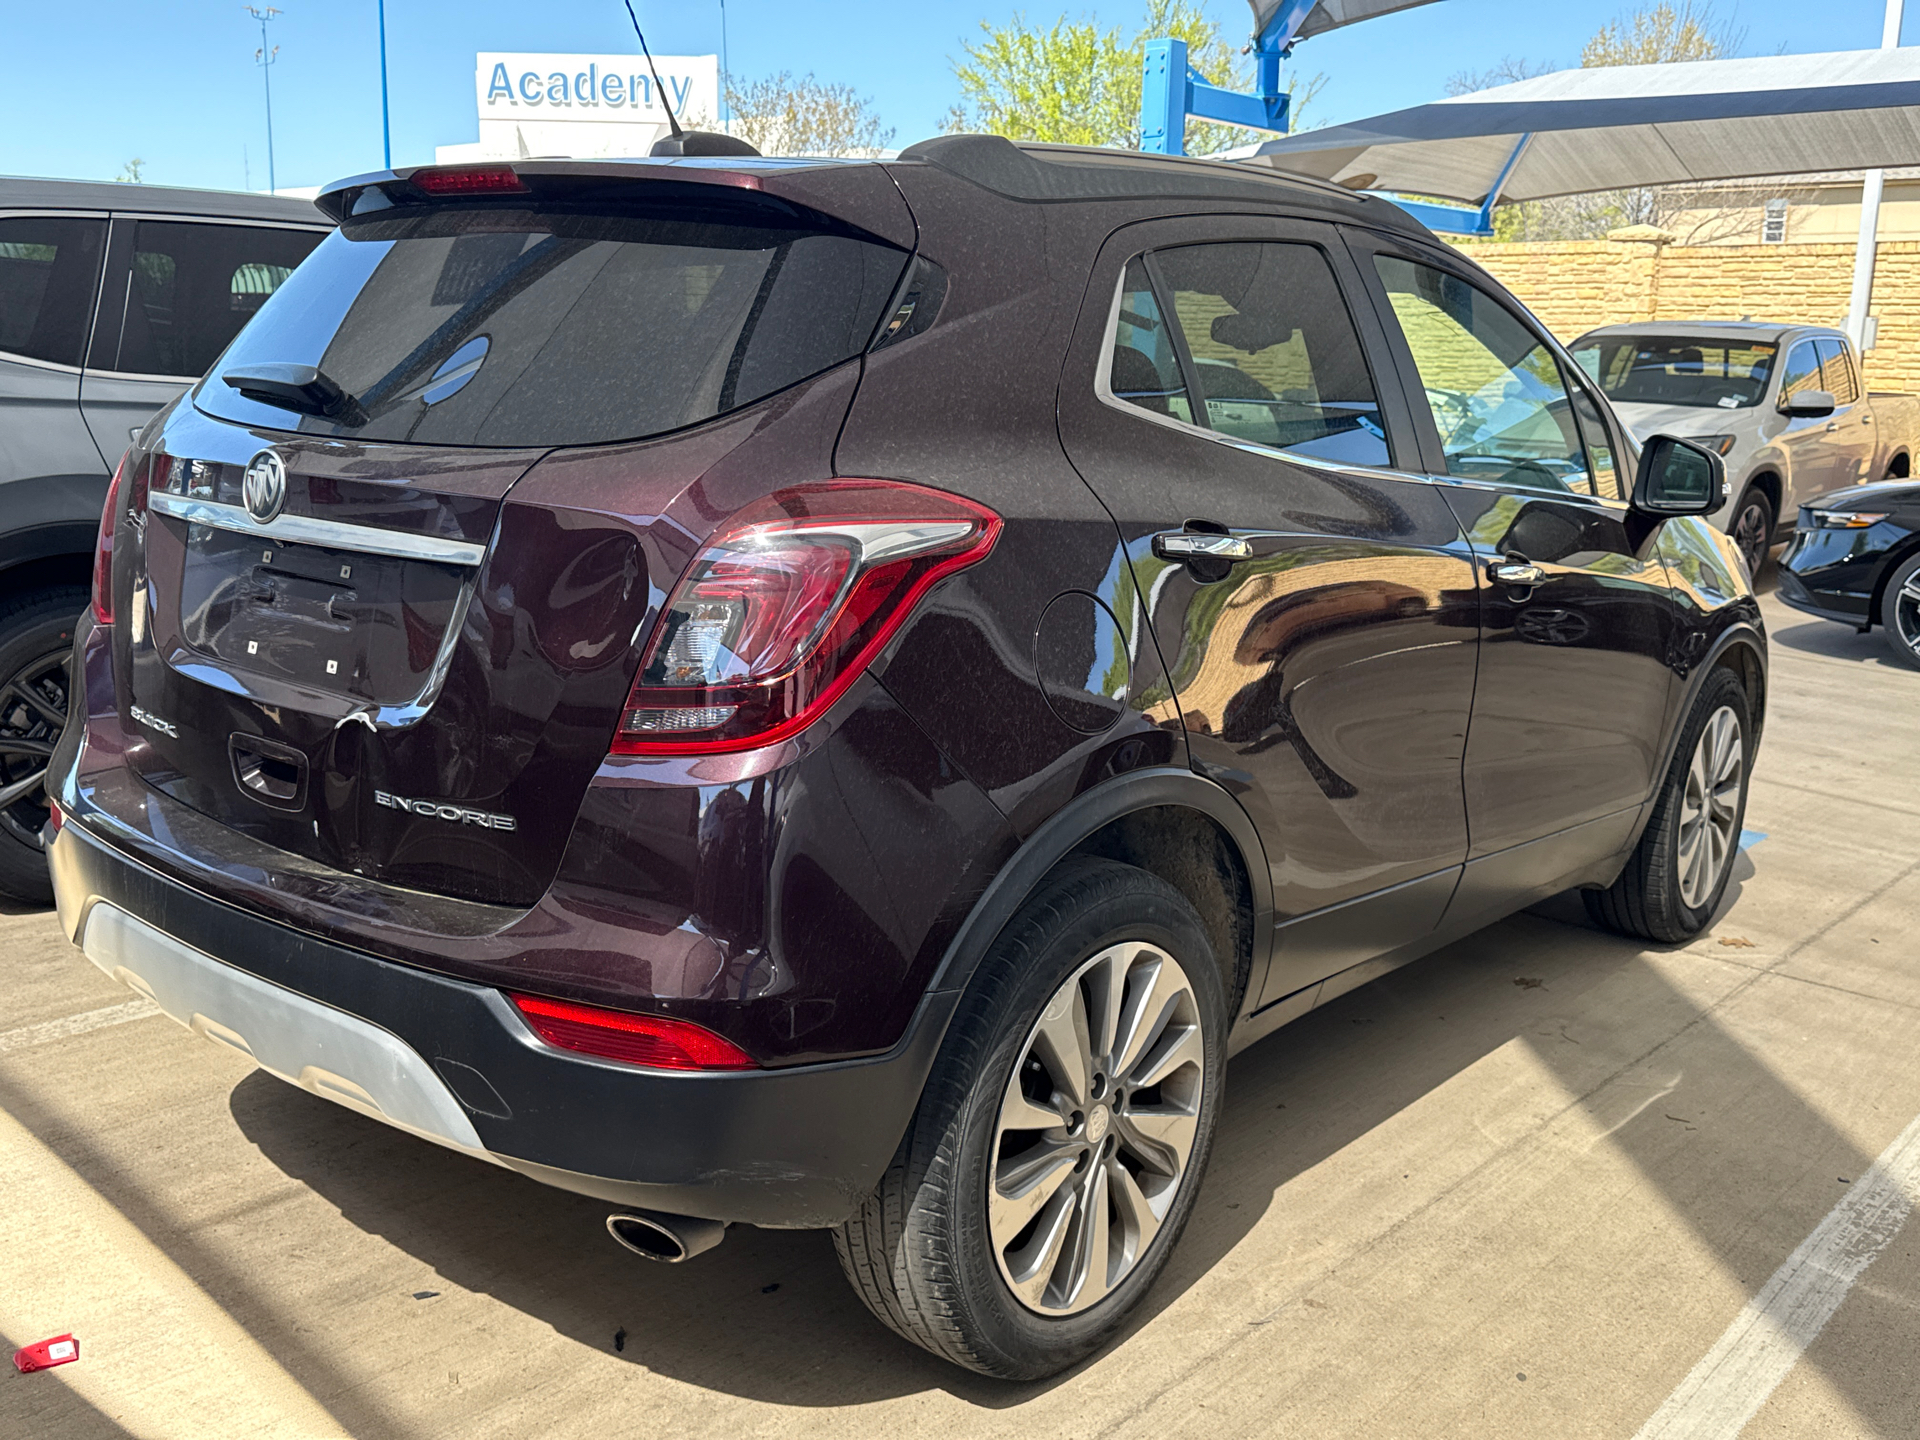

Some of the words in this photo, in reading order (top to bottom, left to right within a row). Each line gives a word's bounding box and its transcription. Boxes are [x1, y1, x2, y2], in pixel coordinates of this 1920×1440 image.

[486, 62, 692, 116] Academy
[130, 705, 179, 739] BUICK
[374, 789, 517, 832] ENCORE
